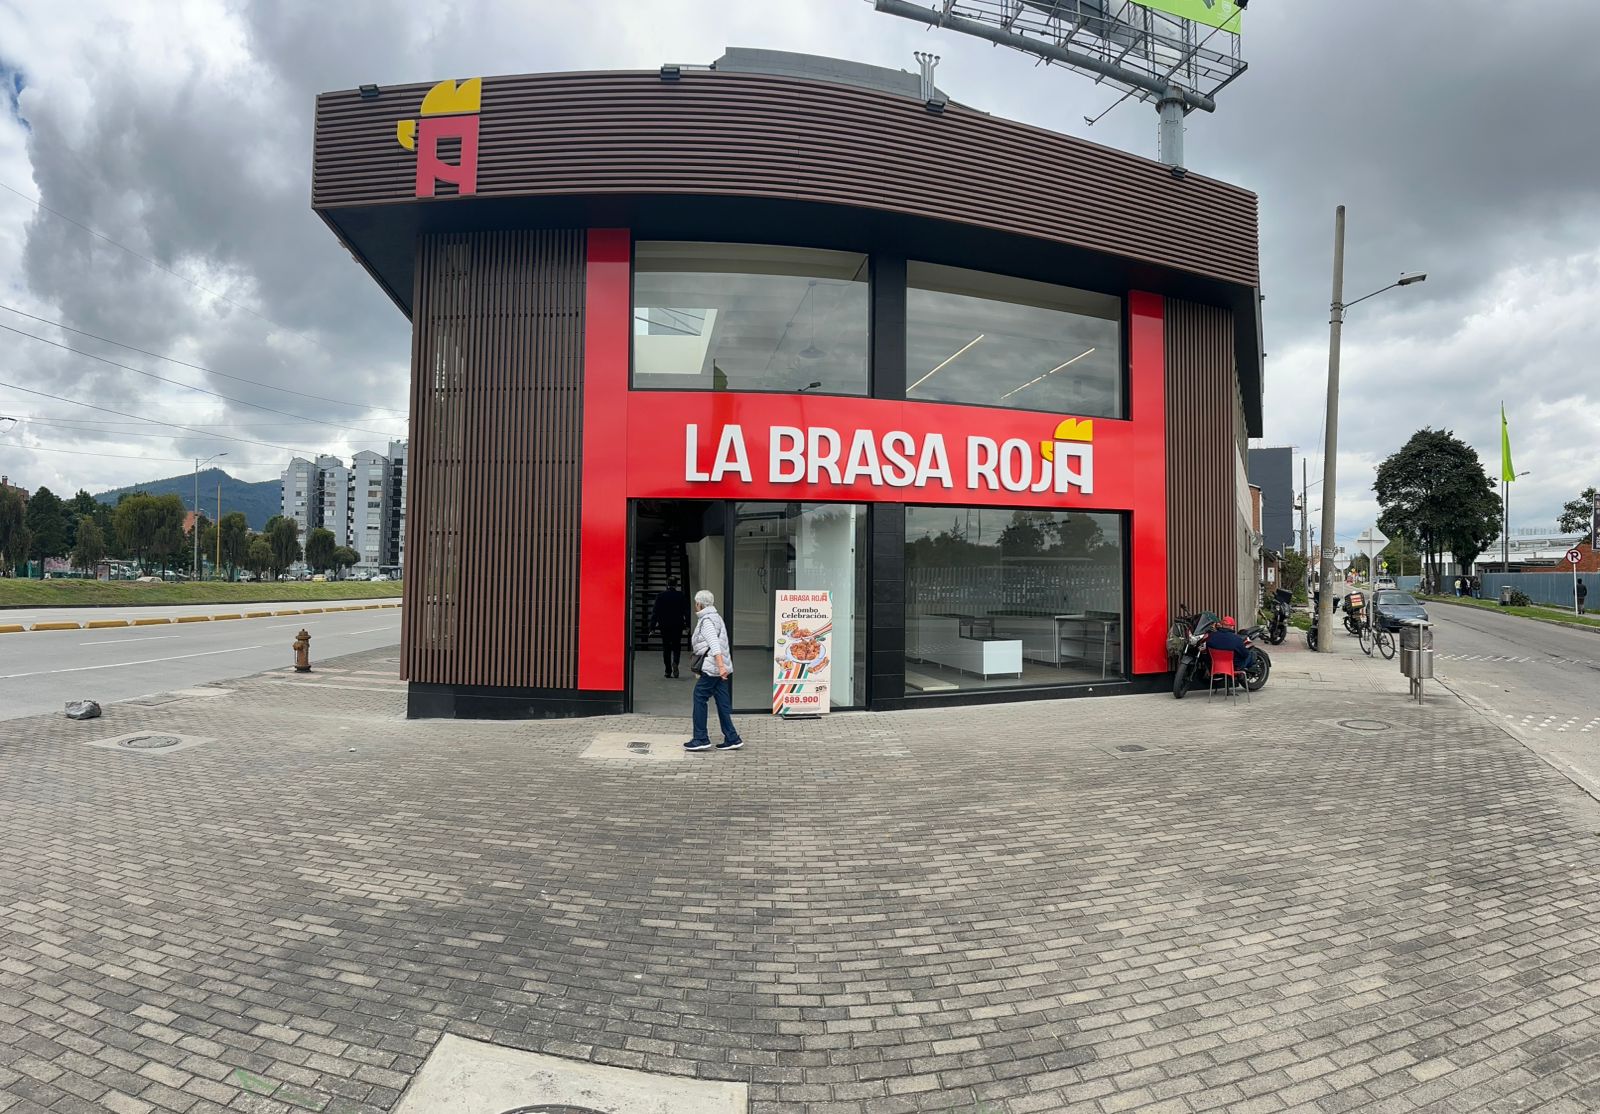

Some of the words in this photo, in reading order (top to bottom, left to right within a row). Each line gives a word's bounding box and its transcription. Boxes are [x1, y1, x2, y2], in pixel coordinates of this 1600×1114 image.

[685, 424, 752, 484] LA
[768, 425, 954, 489] BRASA
[967, 419, 1094, 495] ROJA
[812, 592, 828, 602] ROJA
